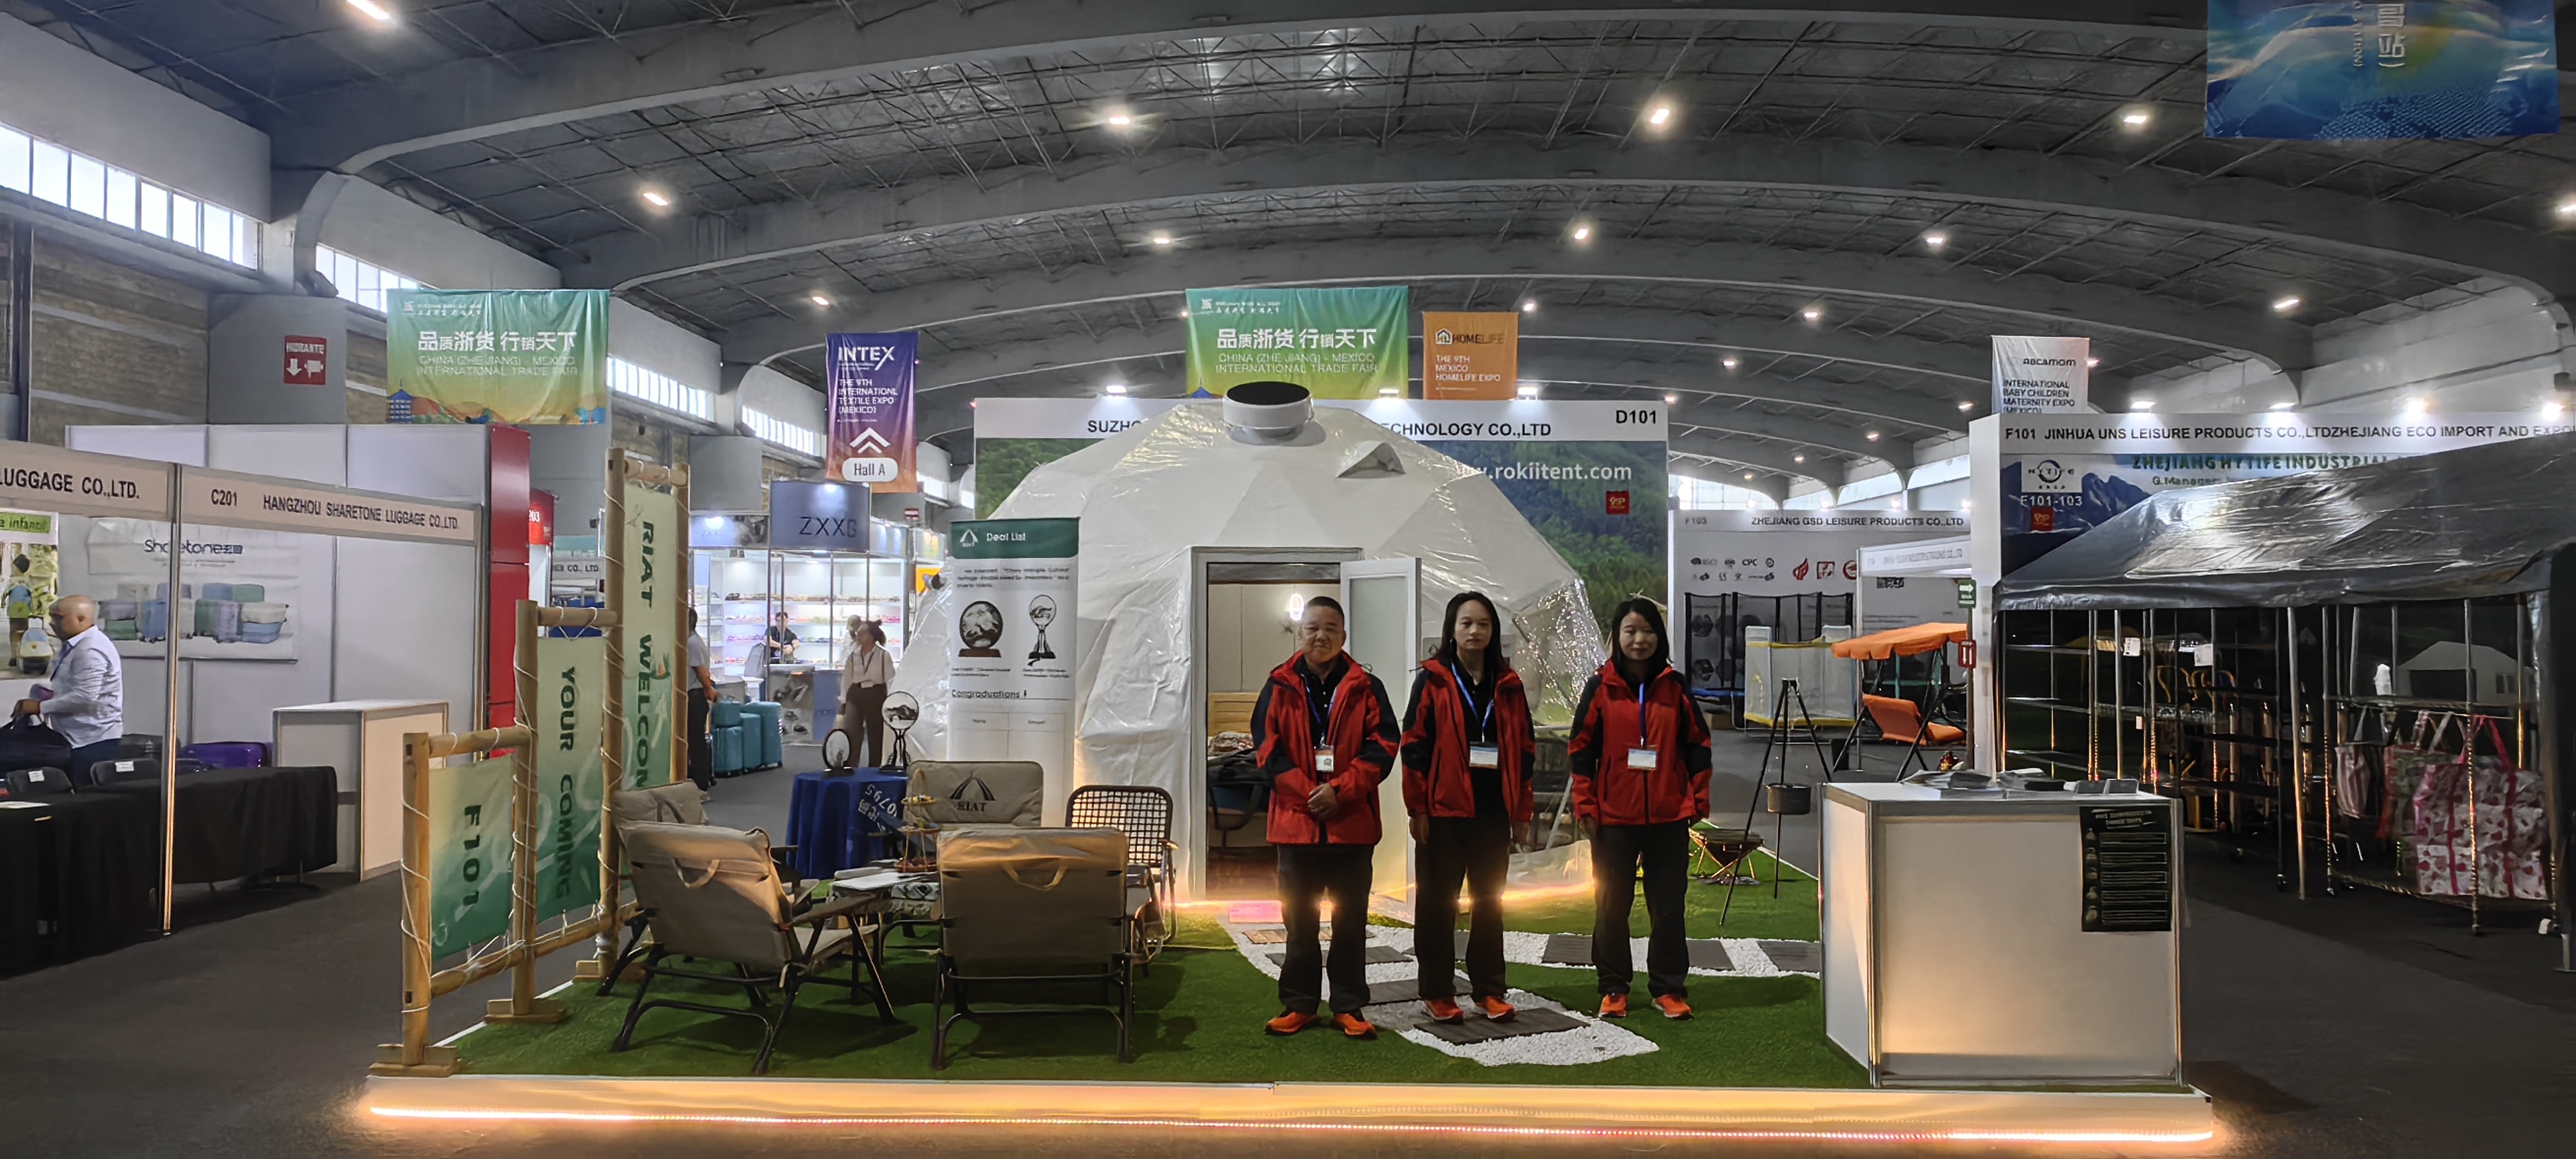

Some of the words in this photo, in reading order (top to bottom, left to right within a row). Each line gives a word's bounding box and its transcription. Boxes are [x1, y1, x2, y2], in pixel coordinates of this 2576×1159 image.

[418, 331, 495, 351] 品质浙货
[1217, 328, 1294, 349] 品质浙货
[419, 356, 453, 365] CHINA
[838, 346, 895, 371] INTEX
[1219, 354, 1253, 363] CHINA
[1332, 354, 1375, 363] MEXICO
[1436, 355, 1452, 363] THE
[416, 366, 508, 376] INTERNATIONAL
[510, 367, 548, 376] TRADE
[1216, 363, 1307, 373] INTERNATIONAL
[1312, 363, 1348, 373] TRADE
[1351, 363, 1378, 373] FAIR
[1435, 364, 1469, 372] MEXICO
[838, 378, 855, 387] THE
[856, 378, 872, 386] 9TH
[1436, 373, 1477, 381] HOMELIFE
[1479, 374, 1501, 382] EXPO
[2003, 380, 2070, 388] INTERNATIONAL
[2003, 389, 2026, 397] BABY
[2027, 389, 2069, 397] CHILDREN
[872, 397, 895, 405] EXPO
[2003, 398, 2050, 406] MATERNITY
[2053, 399, 2075, 407] EXPO
[1488, 423, 1551, 438] CO.,LTD
[1616, 410, 1657, 425] D101
[2006, 428, 2036, 440] F101
[2045, 428, 2095, 440] JINHUA
[2099, 428, 2126, 440] UNS
[2131, 428, 2191, 440] LEISURE
[2195, 427, 2272, 440] PRODUCTS
[2407, 426, 2436, 437] ECO
[2441, 426, 2494, 438] IMPORT
[2498, 425, 2529, 436] AND
[854, 462, 875, 476] Hall
[878, 464, 886, 476] A
[2133, 456, 2216, 471] ZHEJIANG
[211, 488, 238, 506] C201
[263, 494, 321, 515] HANGZHOU
[326, 501, 381, 521] SHARETONE
[385, 510, 425, 526] LUGGAGE
[799, 516, 858, 538] ZXXG
[1752, 518, 1800, 526] ZHEJIANG
[1826, 518, 1867, 526] LEISURE
[1869, 518, 1923, 526] PRODUCTS
[641, 520, 655, 609] RIAT
[560, 666, 576, 752] YOUR
[555, 774, 575, 900] COMING
[463, 804, 482, 907] F101
